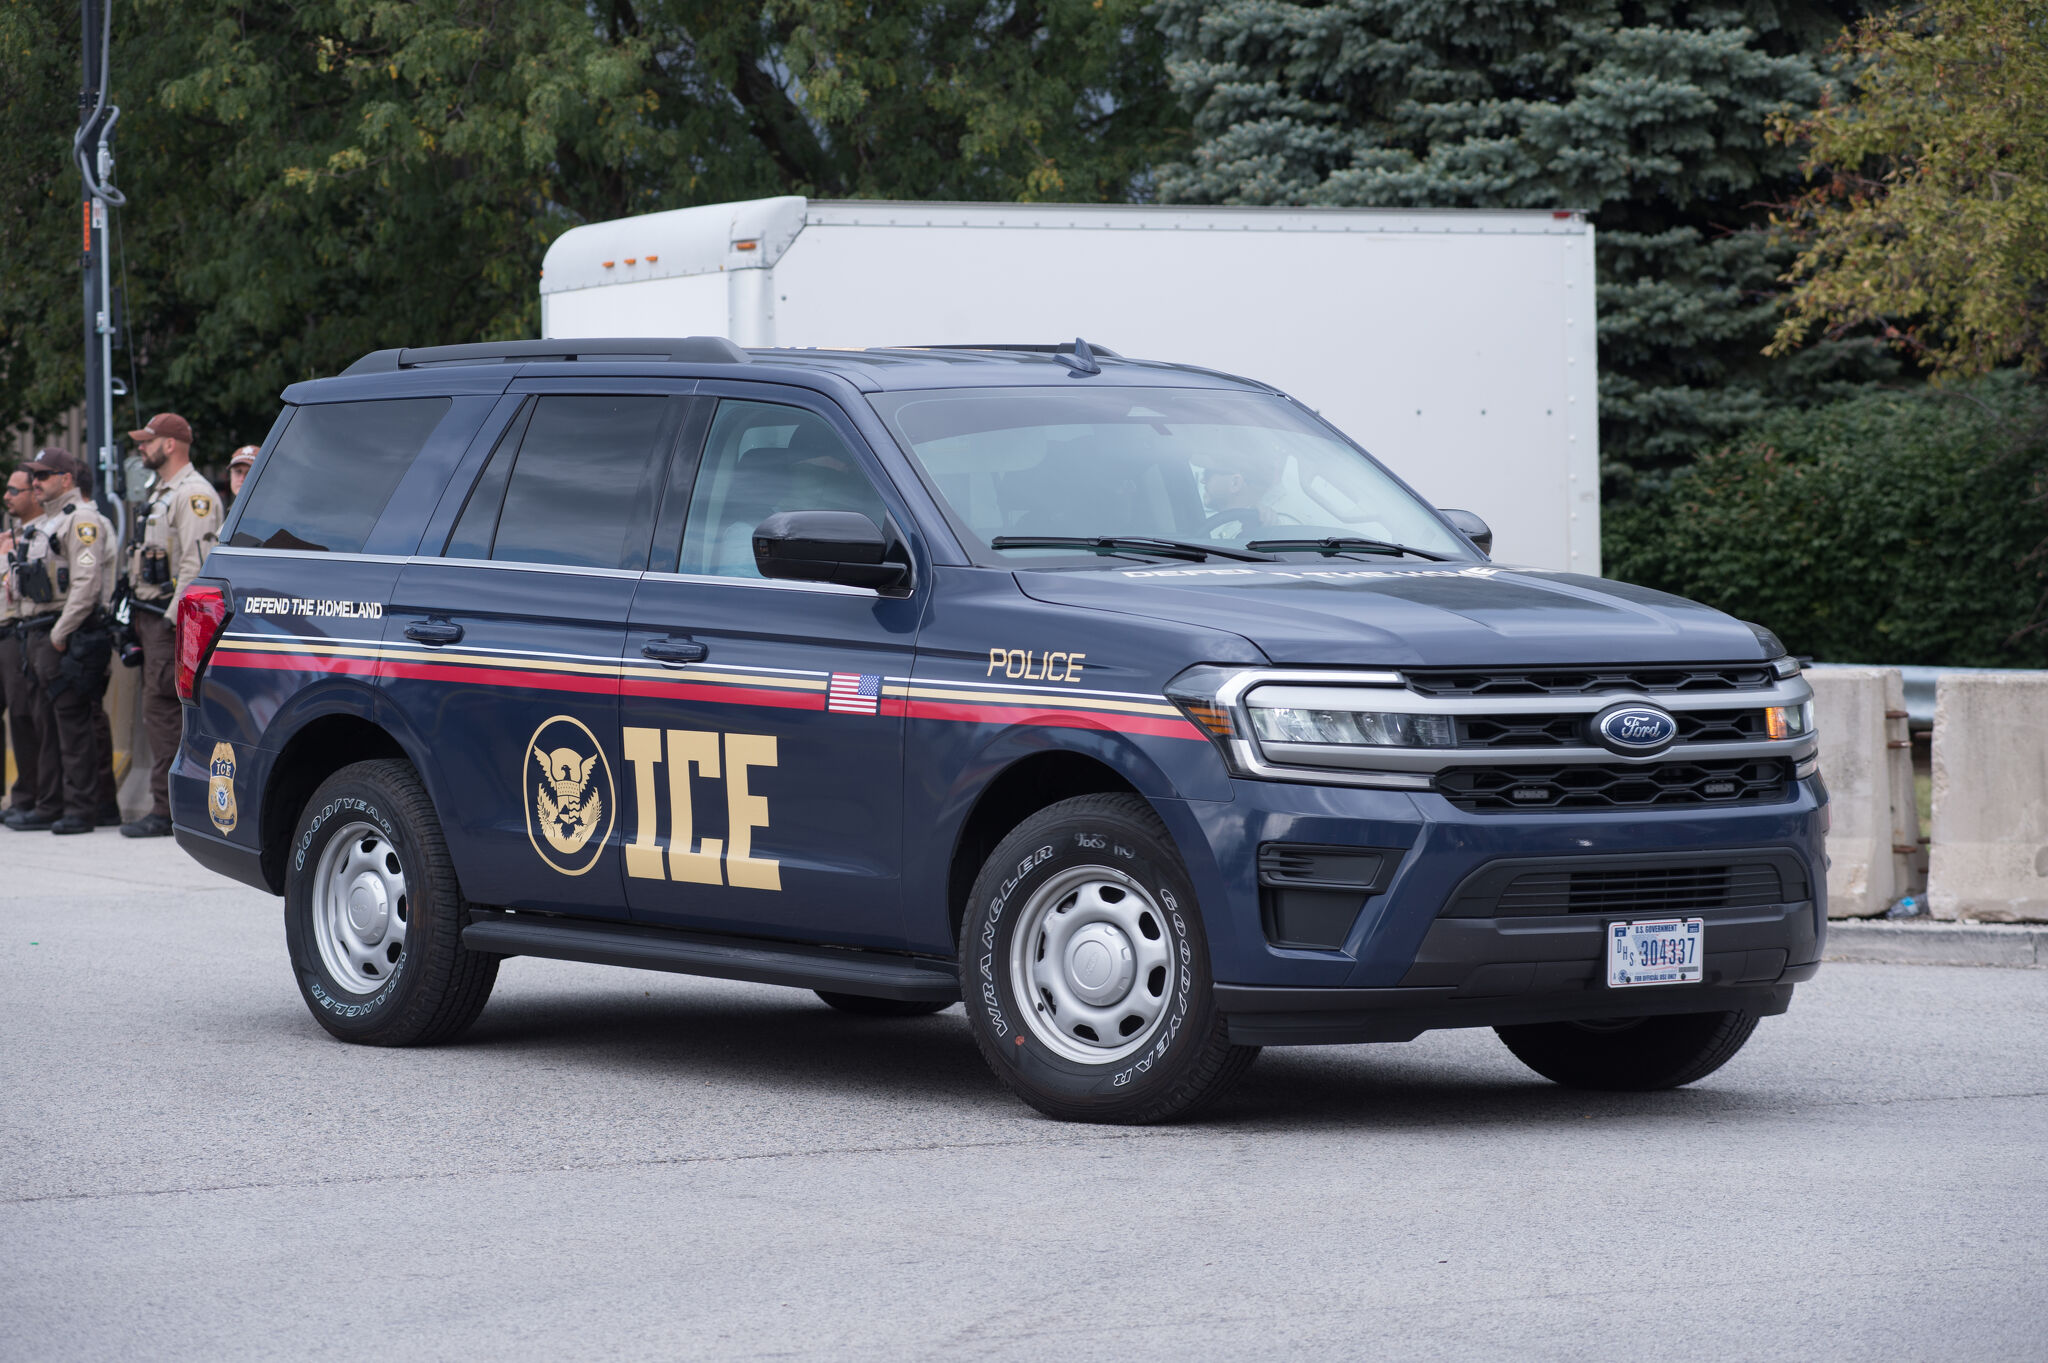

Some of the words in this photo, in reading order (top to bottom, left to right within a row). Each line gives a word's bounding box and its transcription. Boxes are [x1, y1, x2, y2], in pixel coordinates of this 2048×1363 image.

[244, 597, 290, 615] DEFEND
[291, 599, 315, 616] THE
[315, 600, 383, 619] HOMELAND
[986, 648, 1086, 683] POLICE
[1621, 716, 1661, 738] Ford
[216, 763, 231, 777] ICE
[622, 726, 783, 891] ICE
[295, 798, 392, 871] GOODYEAR
[980, 845, 1053, 1037] WRANGLER
[1645, 925, 1677, 934] GOVERNMENT
[1641, 938, 1695, 966] 304337
[311, 951, 408, 1017] WRANGLER
[1114, 888, 1191, 1087] GOODYEAR
